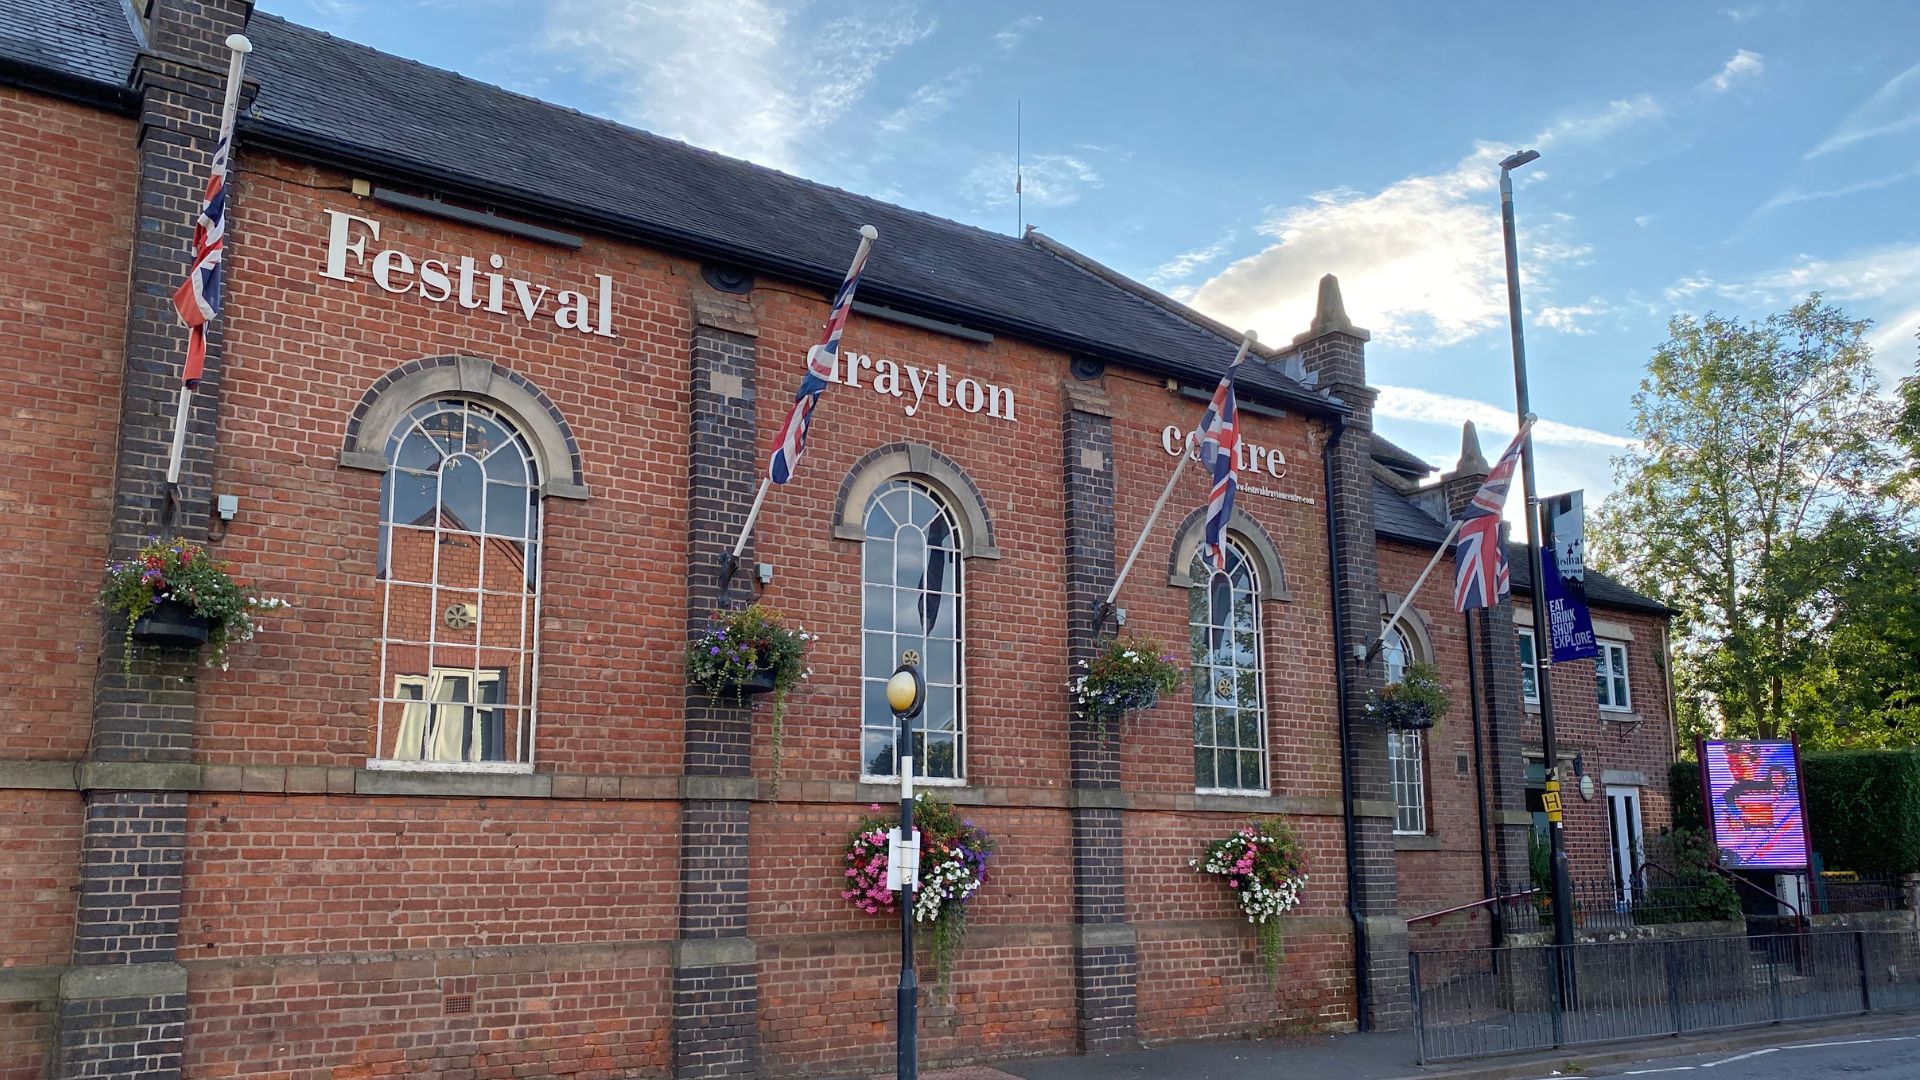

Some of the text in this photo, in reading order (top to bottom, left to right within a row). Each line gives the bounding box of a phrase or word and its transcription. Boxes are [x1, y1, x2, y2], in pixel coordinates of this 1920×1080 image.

[318, 208, 618, 339] Festival
[1161, 425, 1287, 479] cetre
[1549, 598, 1564, 613] EAT
[1550, 608, 1577, 625] DRINK
[1552, 621, 1575, 637] SHOP
[1553, 630, 1593, 649] EXPLORE
[1544, 793, 1559, 810] H
